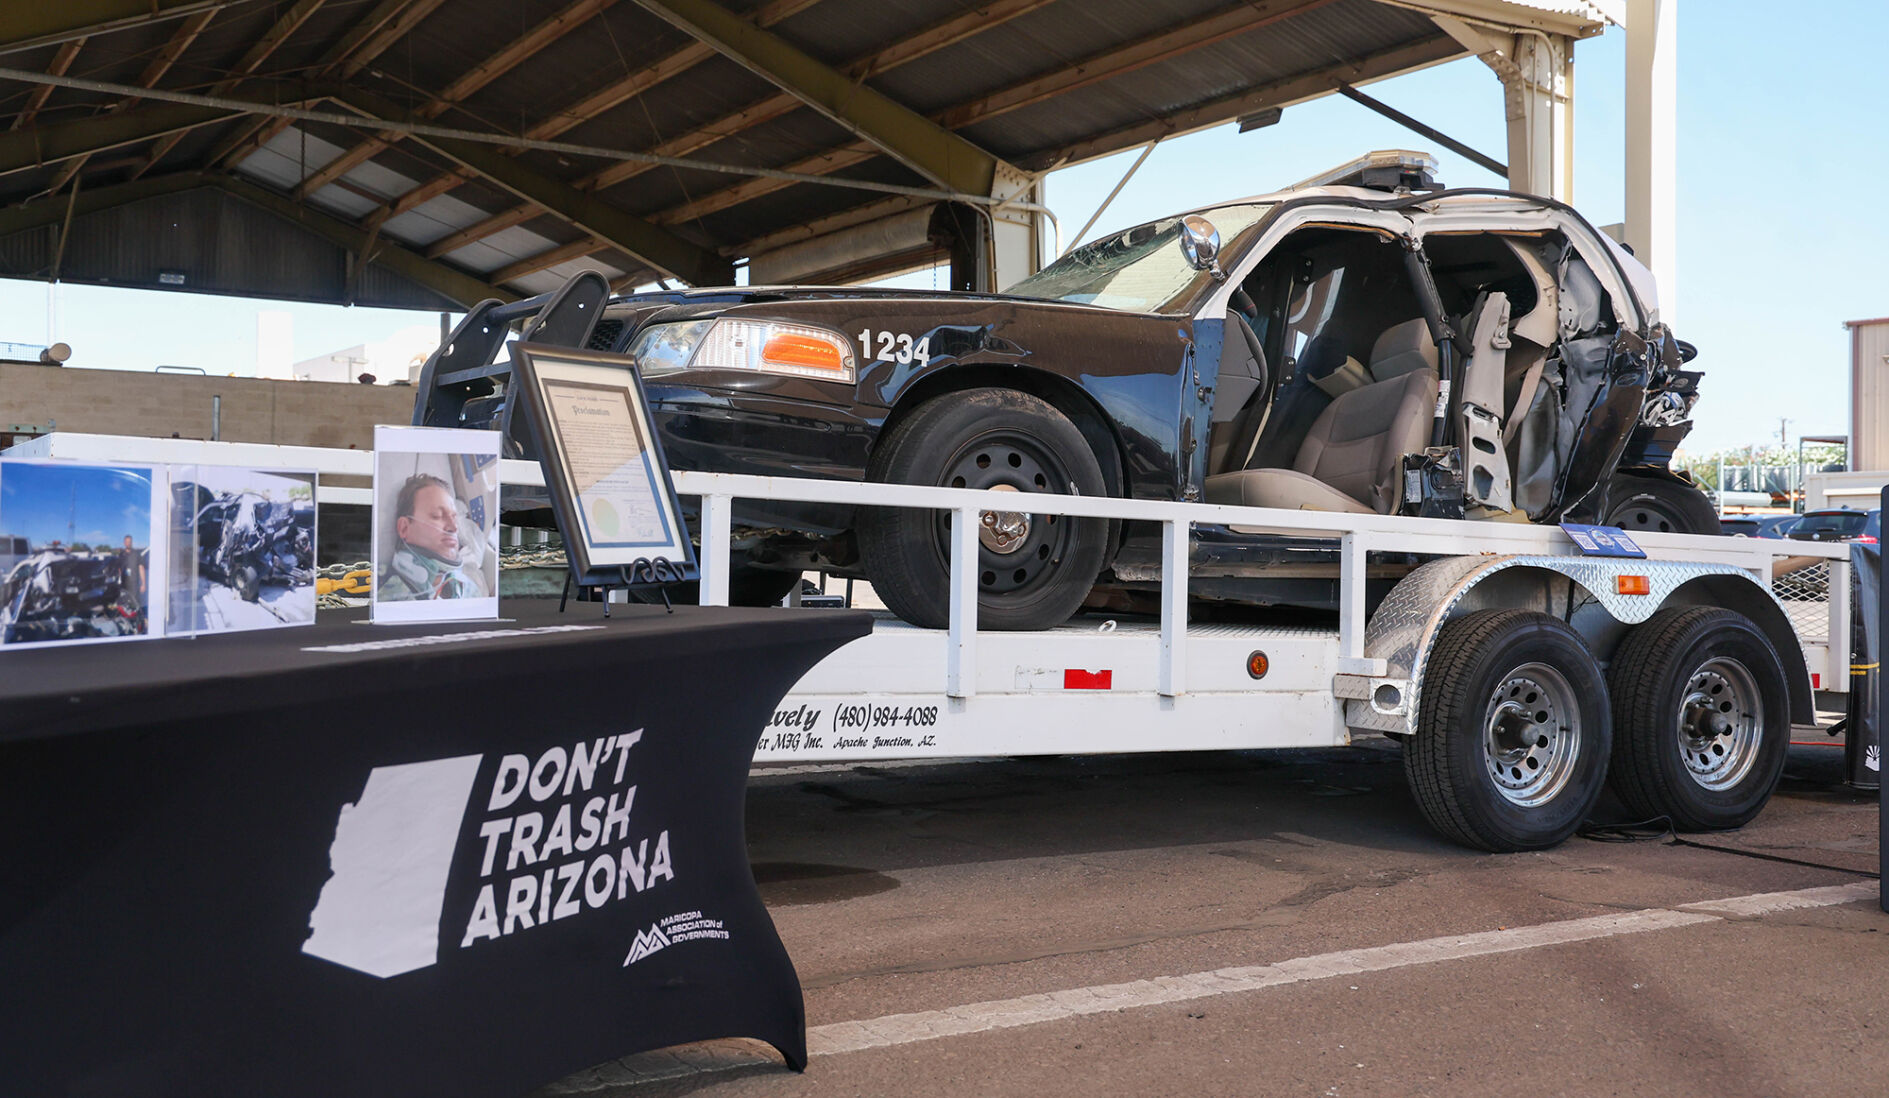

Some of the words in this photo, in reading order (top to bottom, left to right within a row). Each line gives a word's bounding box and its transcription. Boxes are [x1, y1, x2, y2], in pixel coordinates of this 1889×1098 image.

[858, 328, 930, 368] 1234
[766, 703, 822, 732] vely
[803, 732, 824, 750] Inc.
[833, 735, 868, 748] Apache
[872, 736, 914, 749] Junction,
[487, 728, 644, 811] DON'T
[479, 785, 637, 877] TRASH
[460, 830, 675, 948] ARIZONA
[660, 910, 702, 928] MARICOPA
[666, 919, 716, 936] ASSOCIATION
[672, 930, 729, 944] GOVERNMENTS
